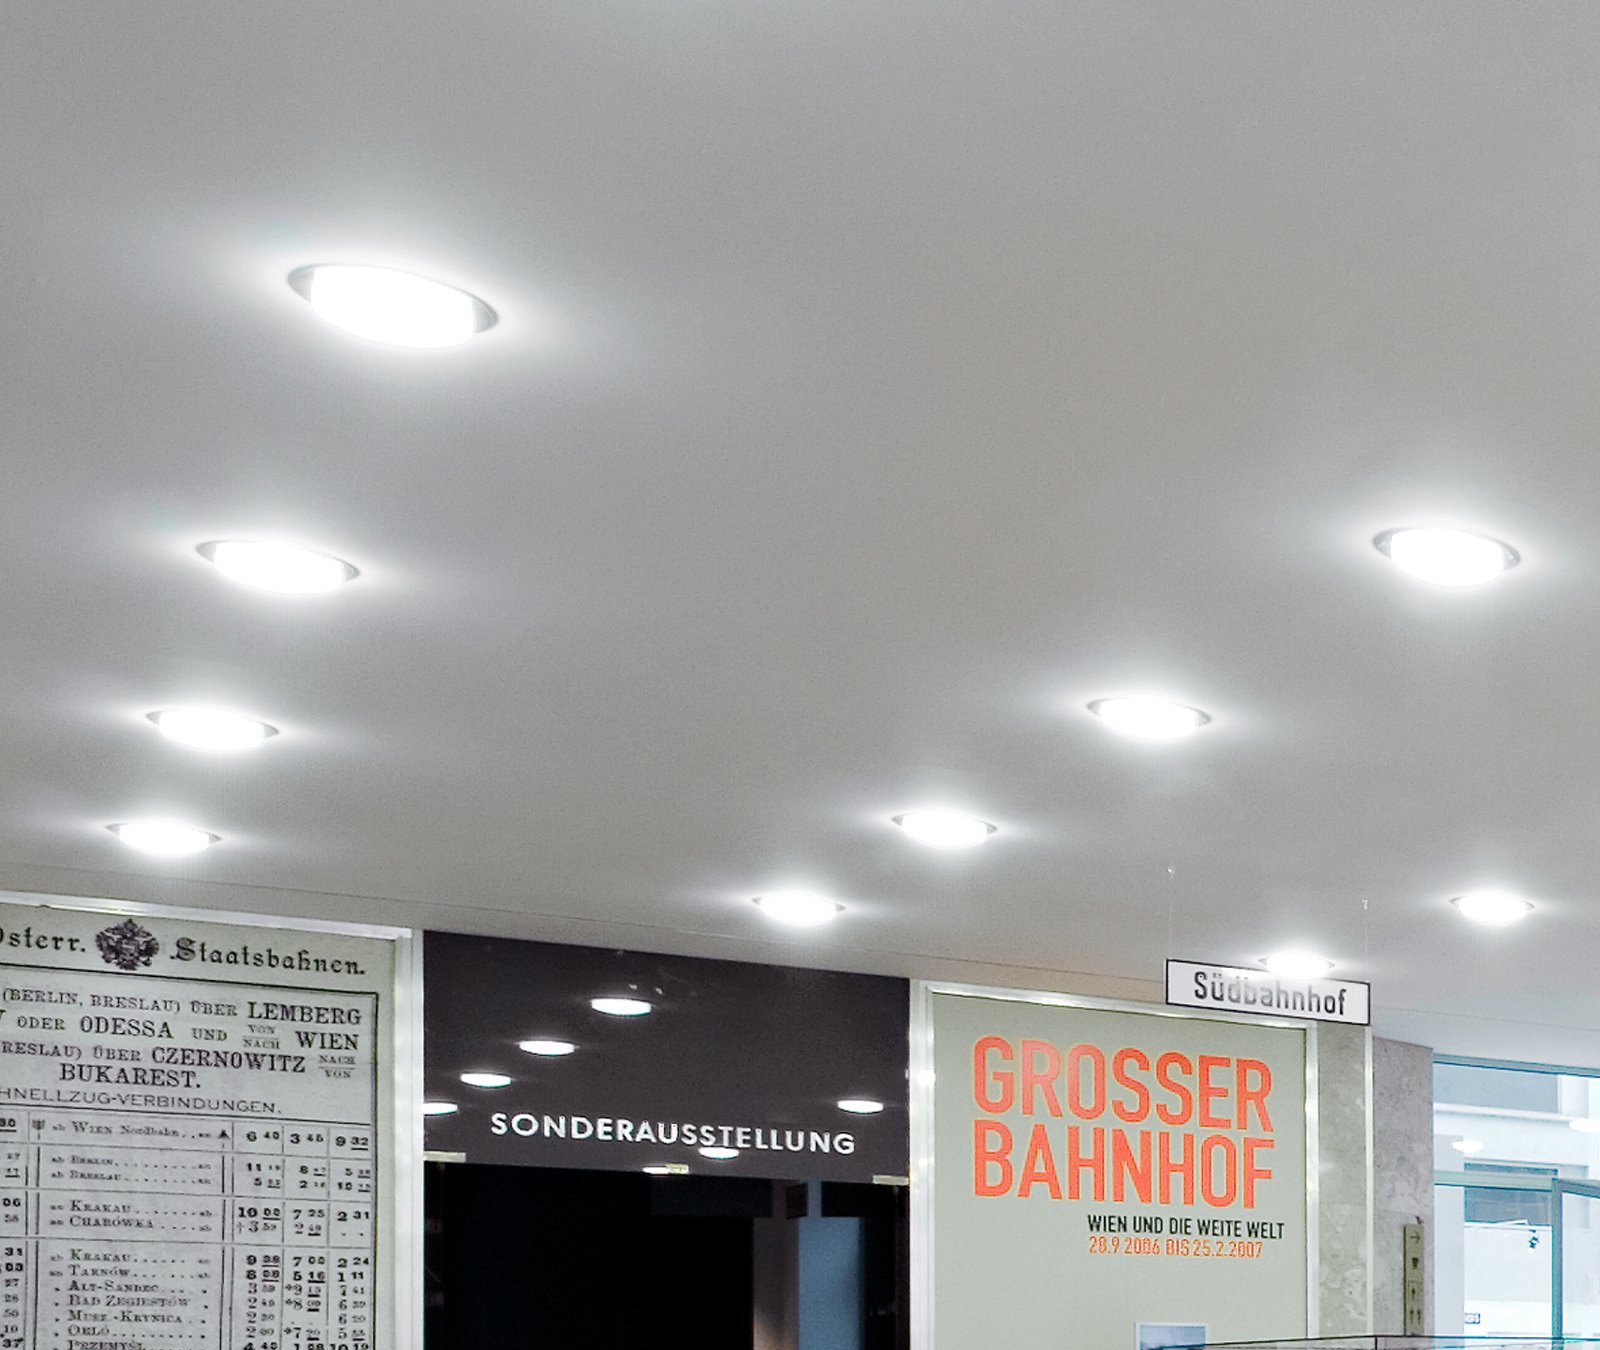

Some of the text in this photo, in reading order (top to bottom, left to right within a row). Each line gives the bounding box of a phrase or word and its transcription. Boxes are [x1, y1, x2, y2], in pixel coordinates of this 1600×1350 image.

[1194, 971, 1347, 1017] Südbahnhof
[90, 994, 181, 1013] BRESLAU)
[247, 1001, 362, 1025] LEMBERG
[17, 1014, 228, 1041] ODER ODESSA UND
[295, 1030, 360, 1051] WIEN
[151, 1046, 306, 1073] CZERNOWITZ
[59, 1062, 201, 1089] BUKAREST.
[973, 1035, 1275, 1133] GROSSER
[72, 1120, 113, 1134] WIEN
[490, 1112, 856, 1156] SONDERAUSSTELLUNG
[290, 1133, 301, 1144] 3
[336, 1136, 368, 1147] 9 32
[973, 1119, 1275, 1210] BAHNHOF
[238, 1206, 258, 1218] 10
[293, 1209, 302, 1220] 7
[337, 1210, 369, 1222] 2 31
[1087, 1214, 1286, 1240] WIEN UND DIE WEITE WELT
[1165, 1238, 1190, 1257] BIS
[1193, 1239, 1264, 1259] 25.2.2007
[246, 1254, 257, 1266] 9
[293, 1256, 302, 1267] 7
[337, 1256, 369, 1268] 2 24
[337, 1271, 345, 1282] 1
